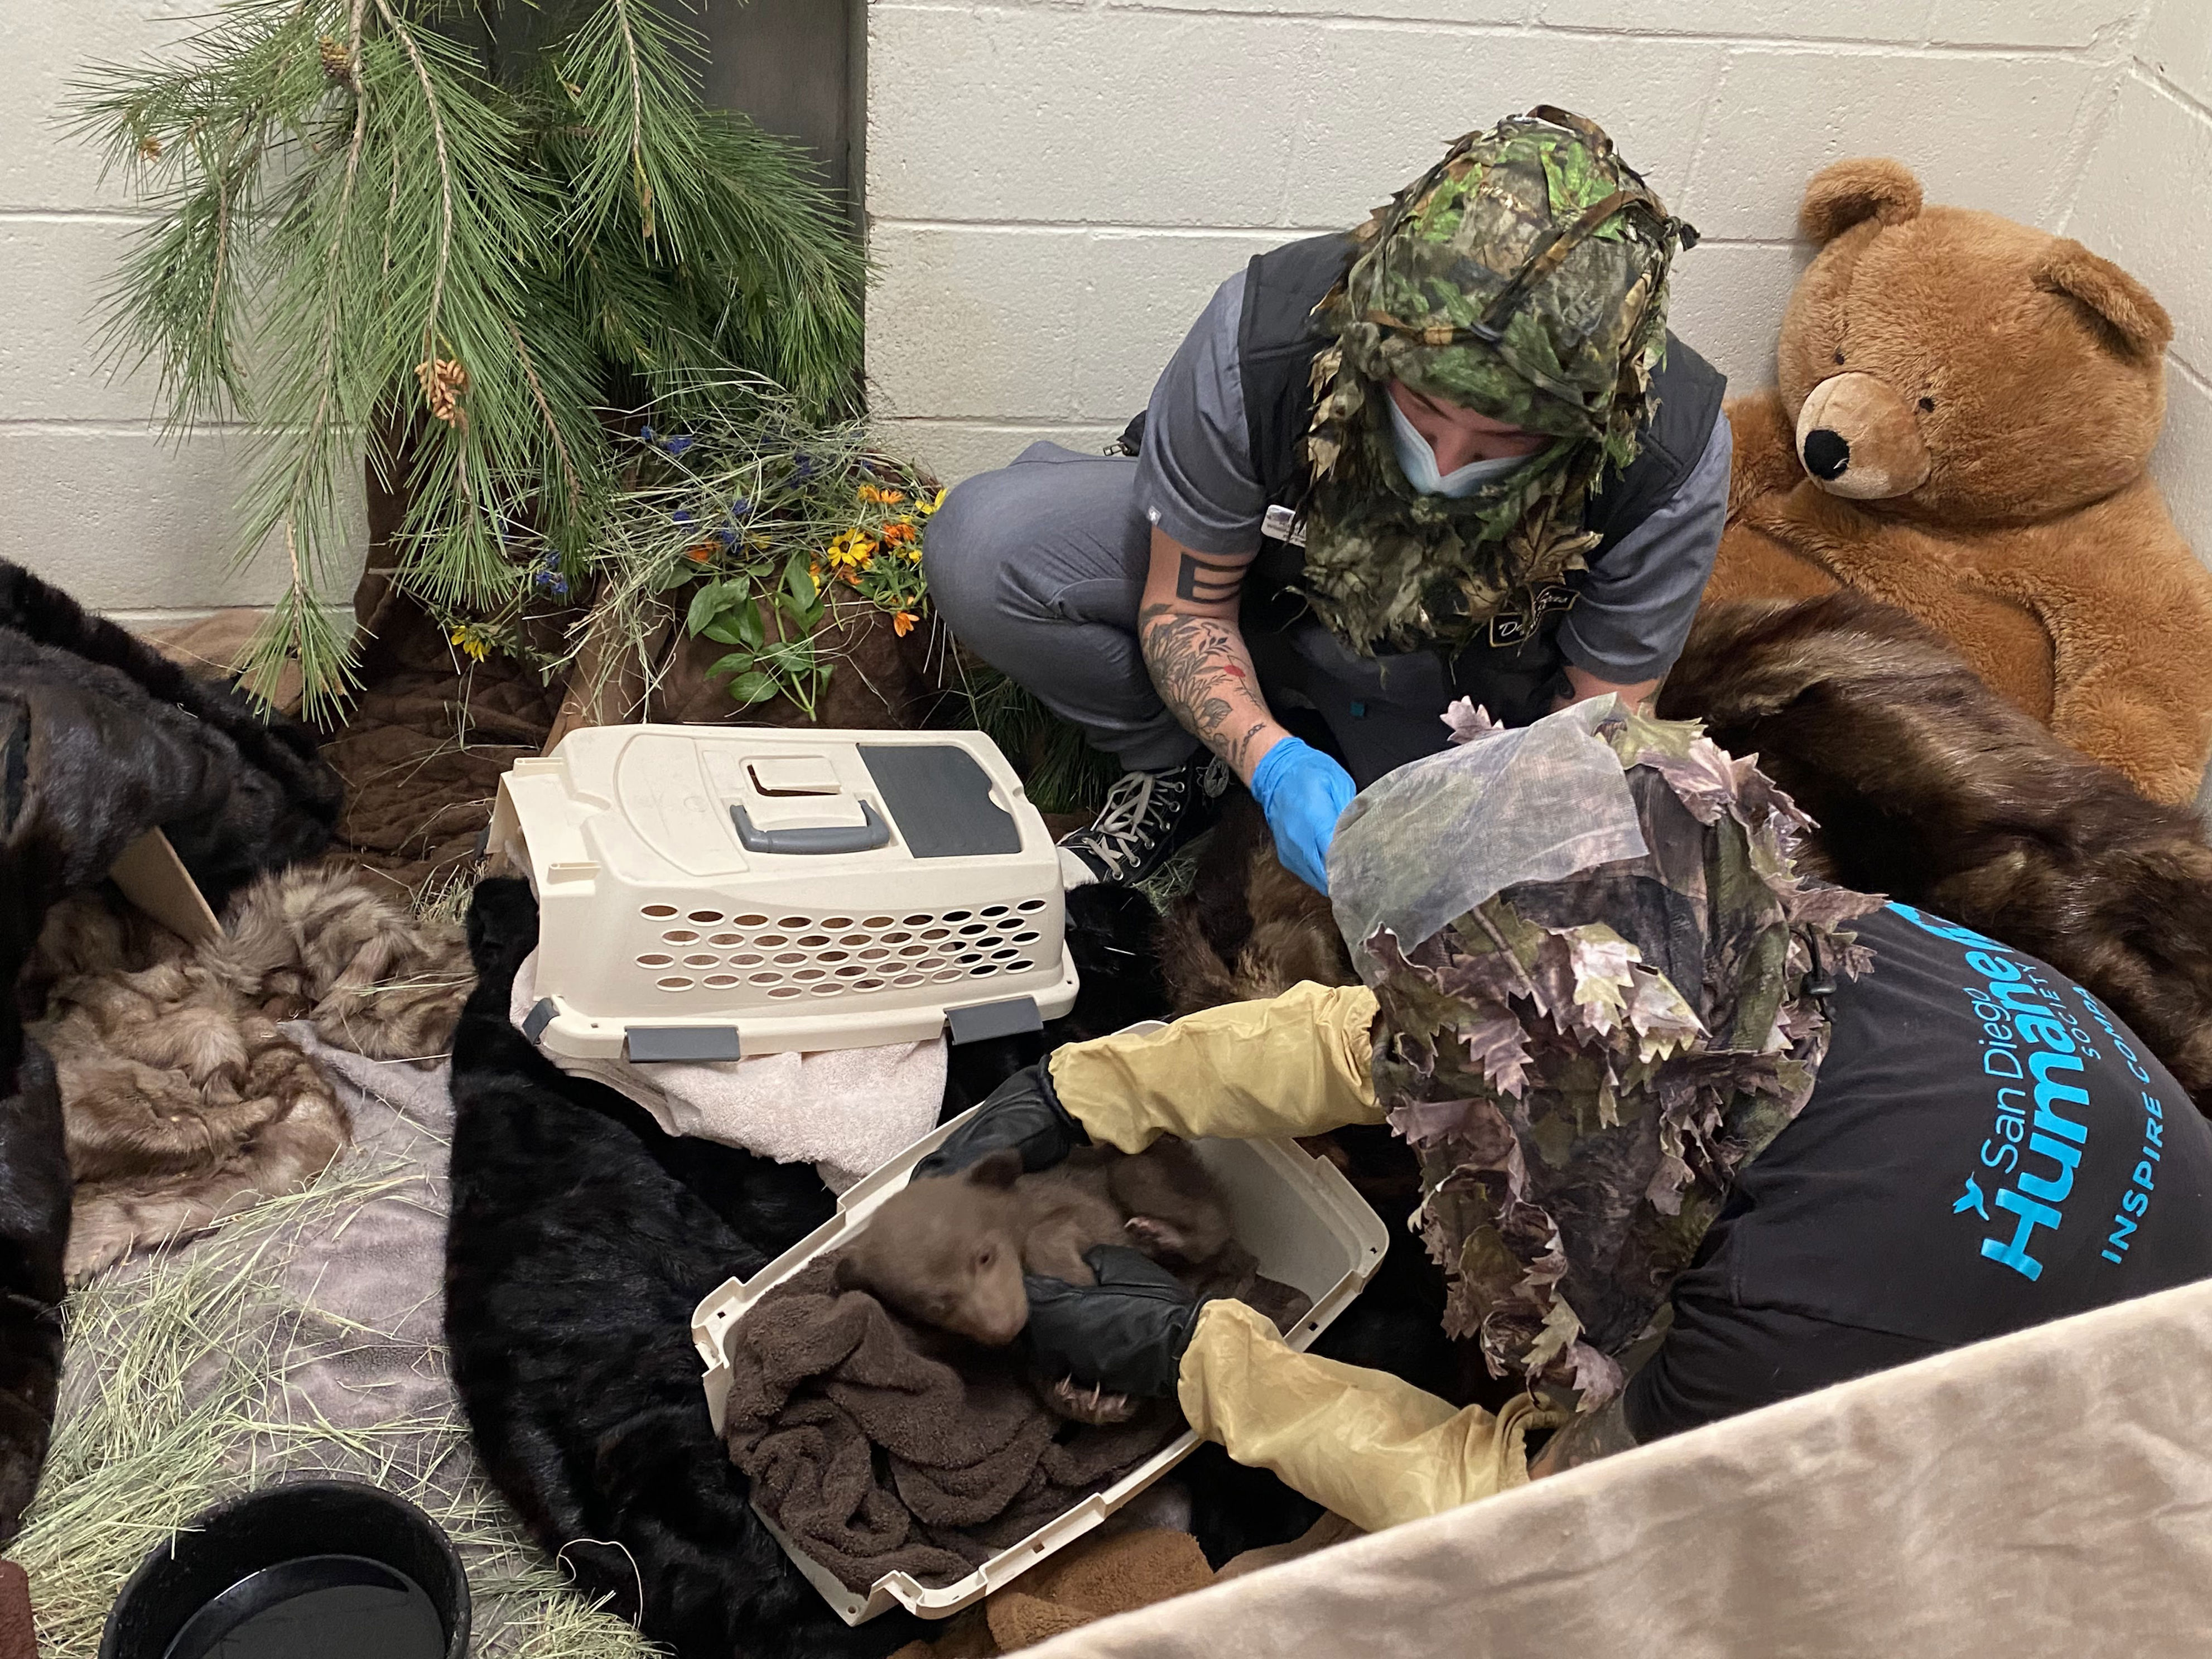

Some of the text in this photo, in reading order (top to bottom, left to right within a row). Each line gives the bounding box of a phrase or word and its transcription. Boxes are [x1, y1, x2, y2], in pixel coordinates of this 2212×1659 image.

[1963, 987, 2026, 1174] San Diego
[2014, 961, 2102, 1060] SOCIETY
[1965, 950, 2090, 1282] Humane
[2101, 1092, 2163, 1264] INSPIRE
